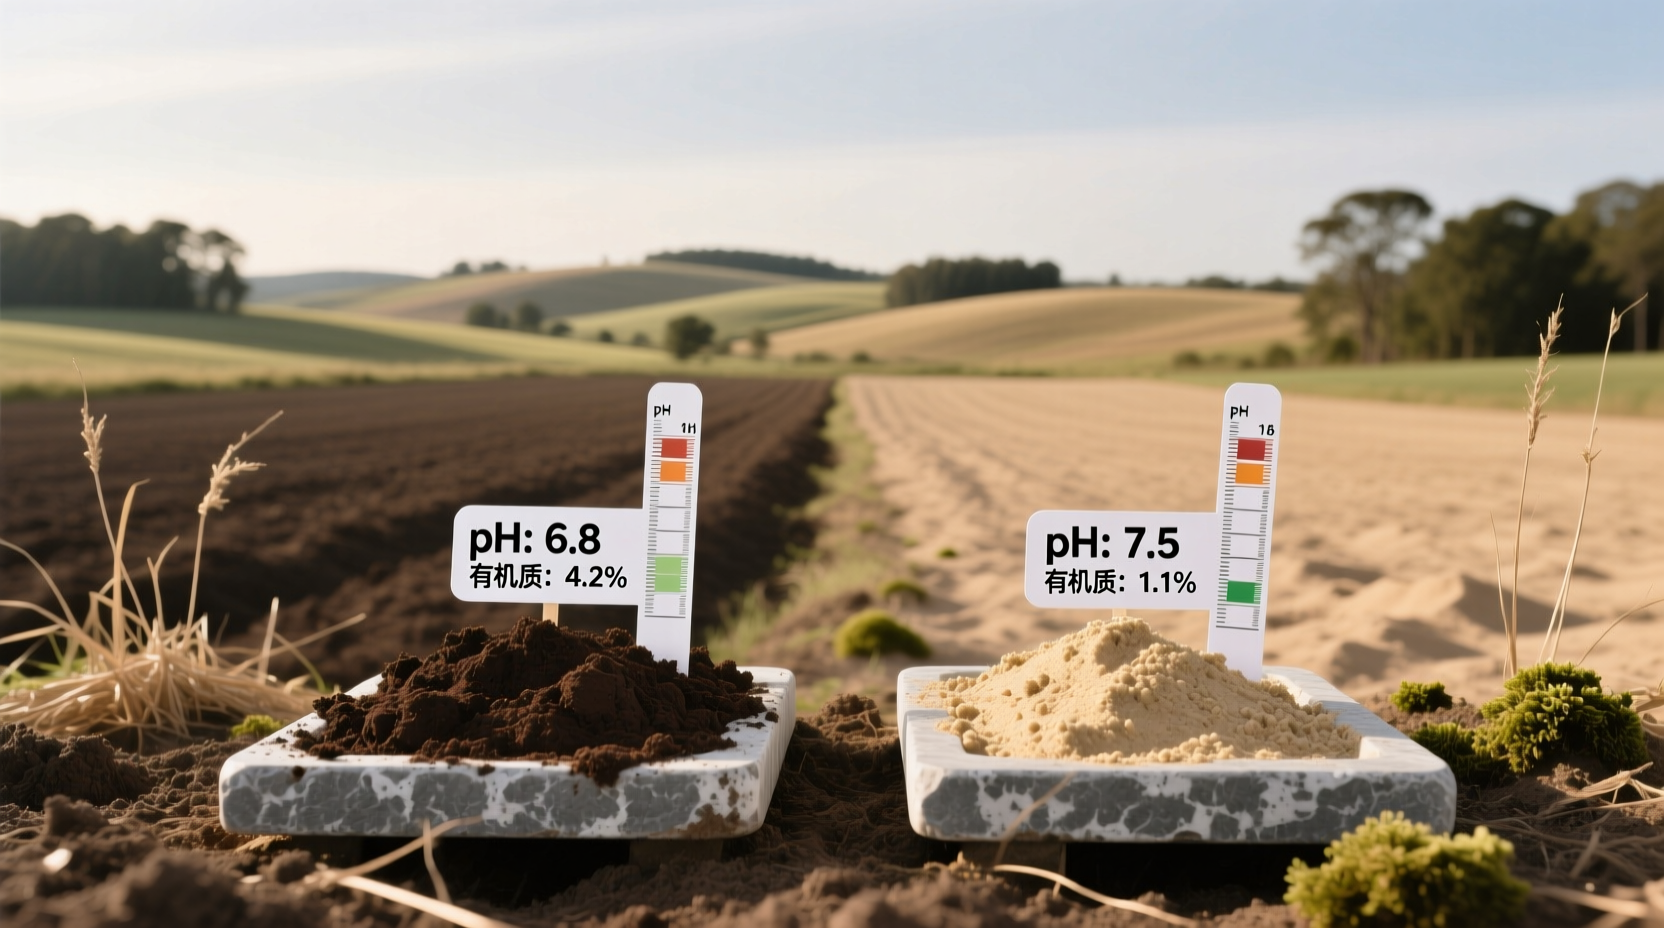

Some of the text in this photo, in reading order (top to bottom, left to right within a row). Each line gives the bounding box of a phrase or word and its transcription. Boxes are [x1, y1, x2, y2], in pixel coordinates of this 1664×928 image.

[653, 404, 671, 418] pH
[1230, 405, 1249, 420] pH
[470, 522, 601, 562] pH: 6.8
[1046, 526, 1180, 566] pH: 7.5
[565, 565, 628, 588] 4.2%
[1139, 570, 1197, 594] 1.1%
